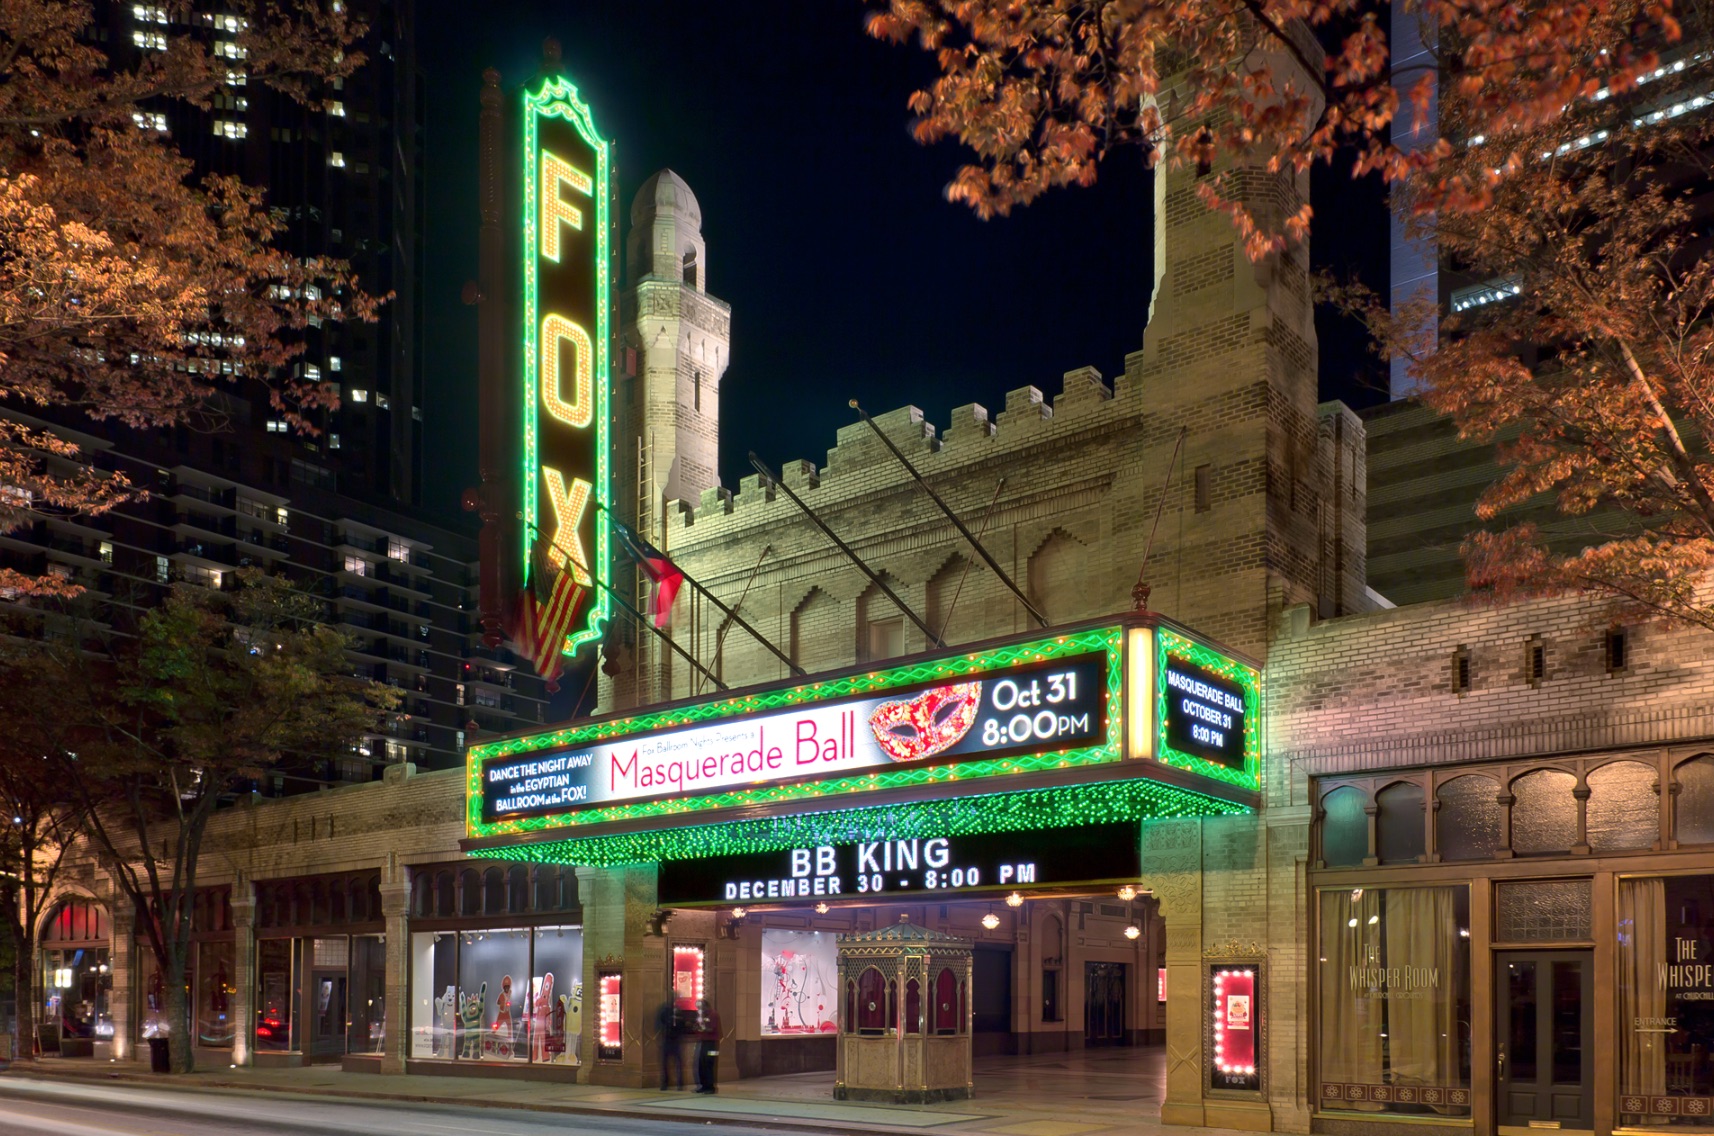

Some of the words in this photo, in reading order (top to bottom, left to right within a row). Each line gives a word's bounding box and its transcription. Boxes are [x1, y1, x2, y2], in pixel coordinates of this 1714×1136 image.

[541, 149, 593, 587] FOX
[992, 680, 1041, 711] Oct
[1046, 671, 1076, 703] 31
[1168, 670, 1223, 705] MASQUERADE
[1224, 693, 1244, 713] BALL
[1183, 699, 1222, 726] OCTOBER
[1222, 714, 1232, 729] 31
[657, 741, 689, 753] Ballroom
[1193, 724, 1209, 742] 8:00
[1211, 730, 1223, 747] PM
[611, 725, 783, 792] Masquerade
[796, 710, 854, 766] Ball
[489, 765, 520, 782] DANCE
[520, 763, 537, 777] THE
[538, 758, 567, 774] NIGHT
[567, 753, 593, 769] AWAY
[496, 794, 545, 811] BALLROOM
[551, 793, 561, 804] the
[561, 785, 587, 802] FOX!
[510, 785, 516, 794] in
[516, 782, 525, 793] the
[525, 774, 570, 791] EGYPTIAN
[792, 845, 836, 878] BB
[858, 837, 949, 873] KING
[725, 876, 841, 900] DECEMBER
[857, 873, 883, 893] 30
[925, 866, 980, 889] 8:00
[999, 863, 1036, 884] PM
[1364, 943, 1380, 965] THE
[1674, 937, 1697, 963] THE
[1349, 965, 1400, 991] WHISPER
[1404, 964, 1438, 991] ROOM
[1657, 962, 1712, 992] WHISPE
[1634, 1017, 1677, 1026] ENTRANCE
[1225, 1076, 1245, 1084] FOX
